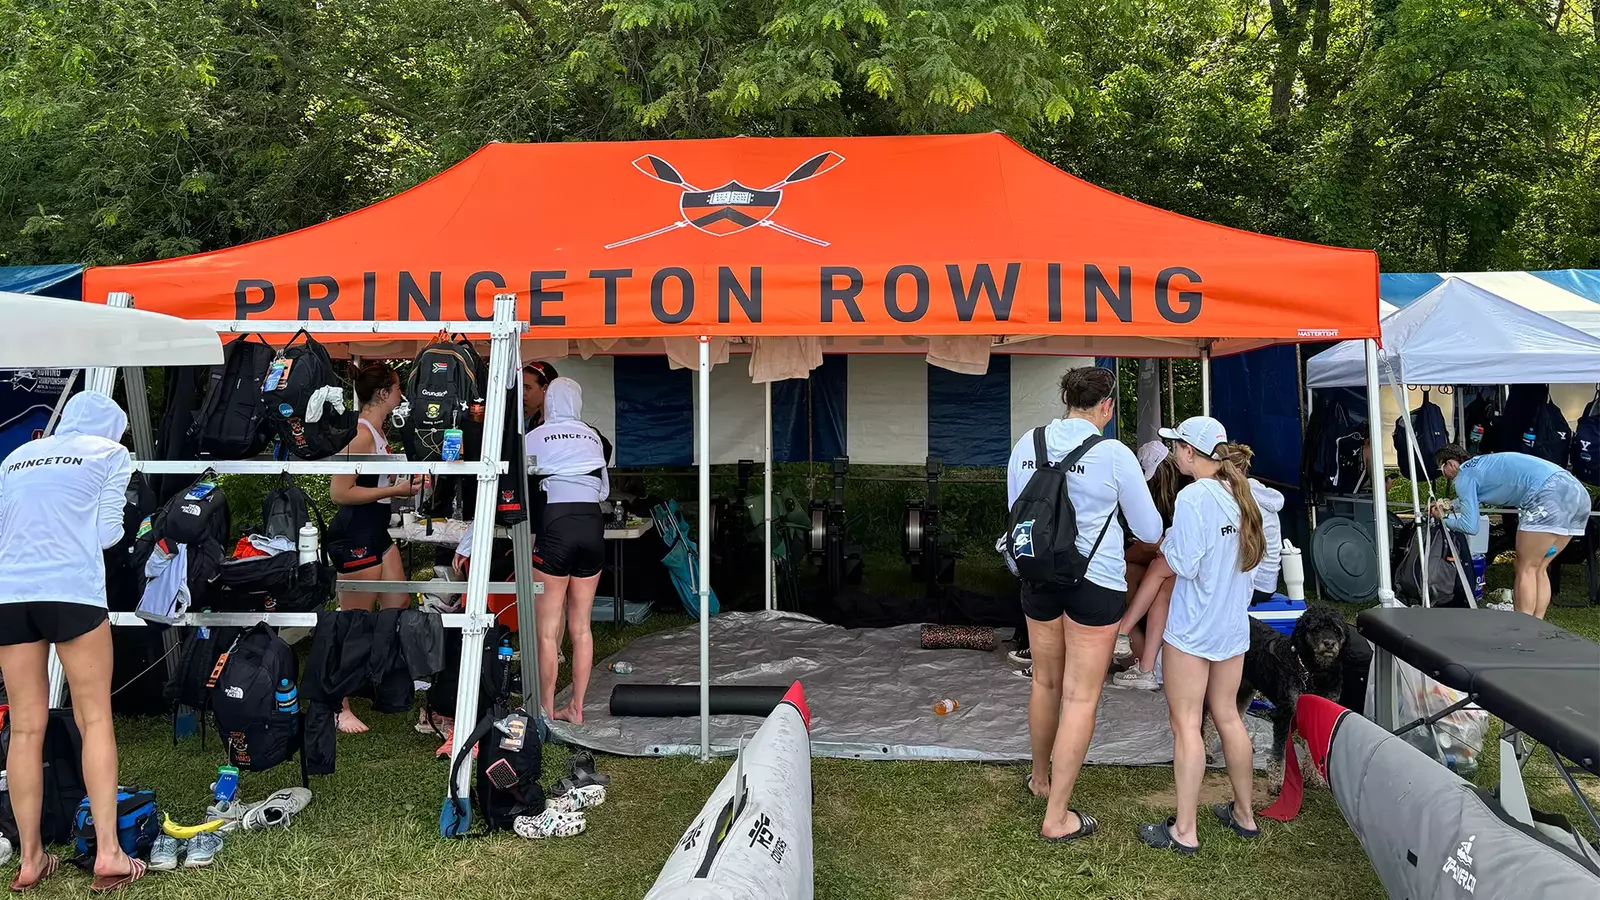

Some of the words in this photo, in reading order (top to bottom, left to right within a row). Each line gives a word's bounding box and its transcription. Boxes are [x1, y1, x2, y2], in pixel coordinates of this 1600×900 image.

[234, 265, 763, 326] PRINCETON
[820, 262, 1204, 324] ROWING
[1580, 439, 1592, 452] Y
[7, 456, 84, 475] PRINCETON
[1021, 460, 1085, 475] PRICEON
